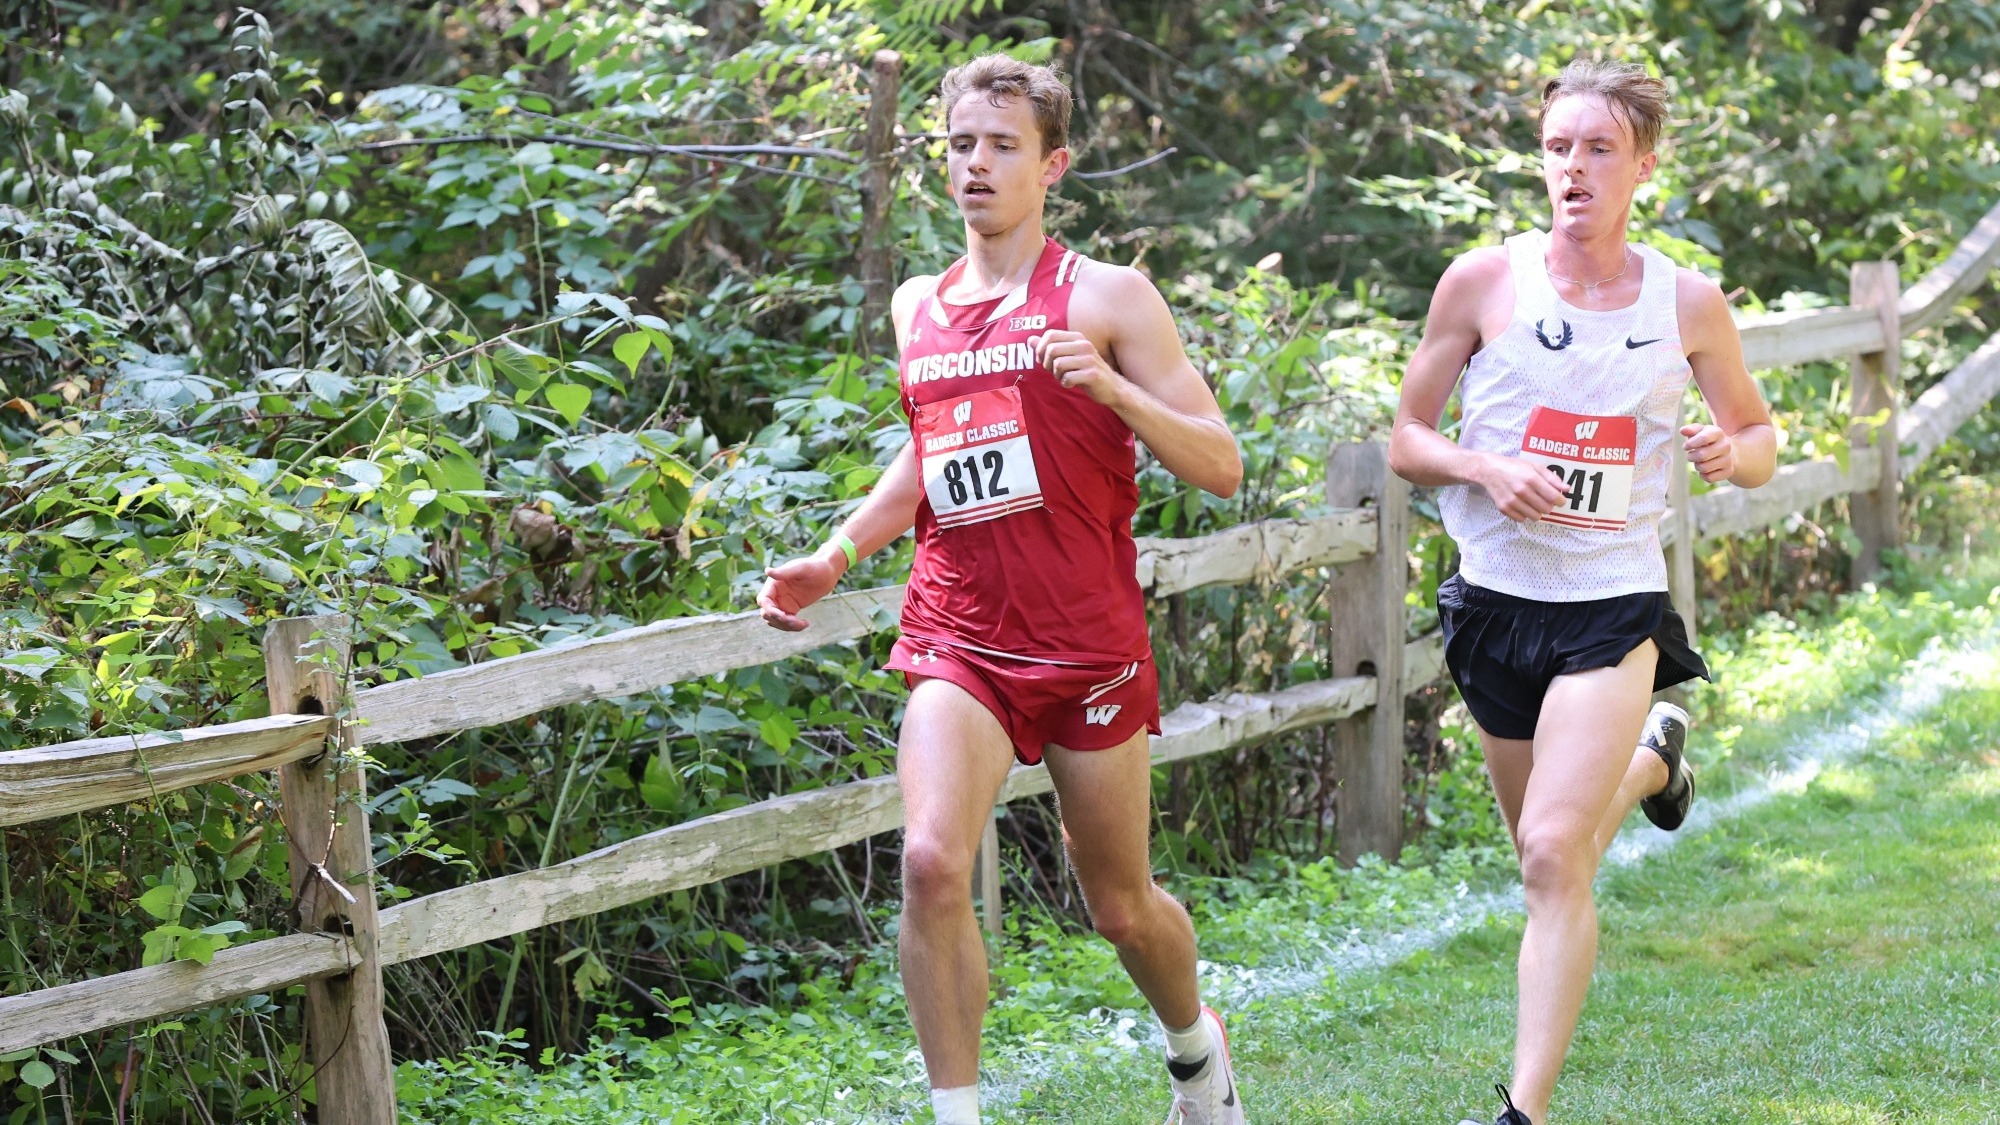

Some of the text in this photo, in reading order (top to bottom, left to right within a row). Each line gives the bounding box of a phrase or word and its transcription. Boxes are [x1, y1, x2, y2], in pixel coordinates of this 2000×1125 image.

[906, 342, 1035, 386] WISCONSIN
[925, 419, 1019, 454] BADGER CLASSIC
[1528, 436, 1631, 462] BADGER CLASSIC
[943, 450, 1010, 506] 812
